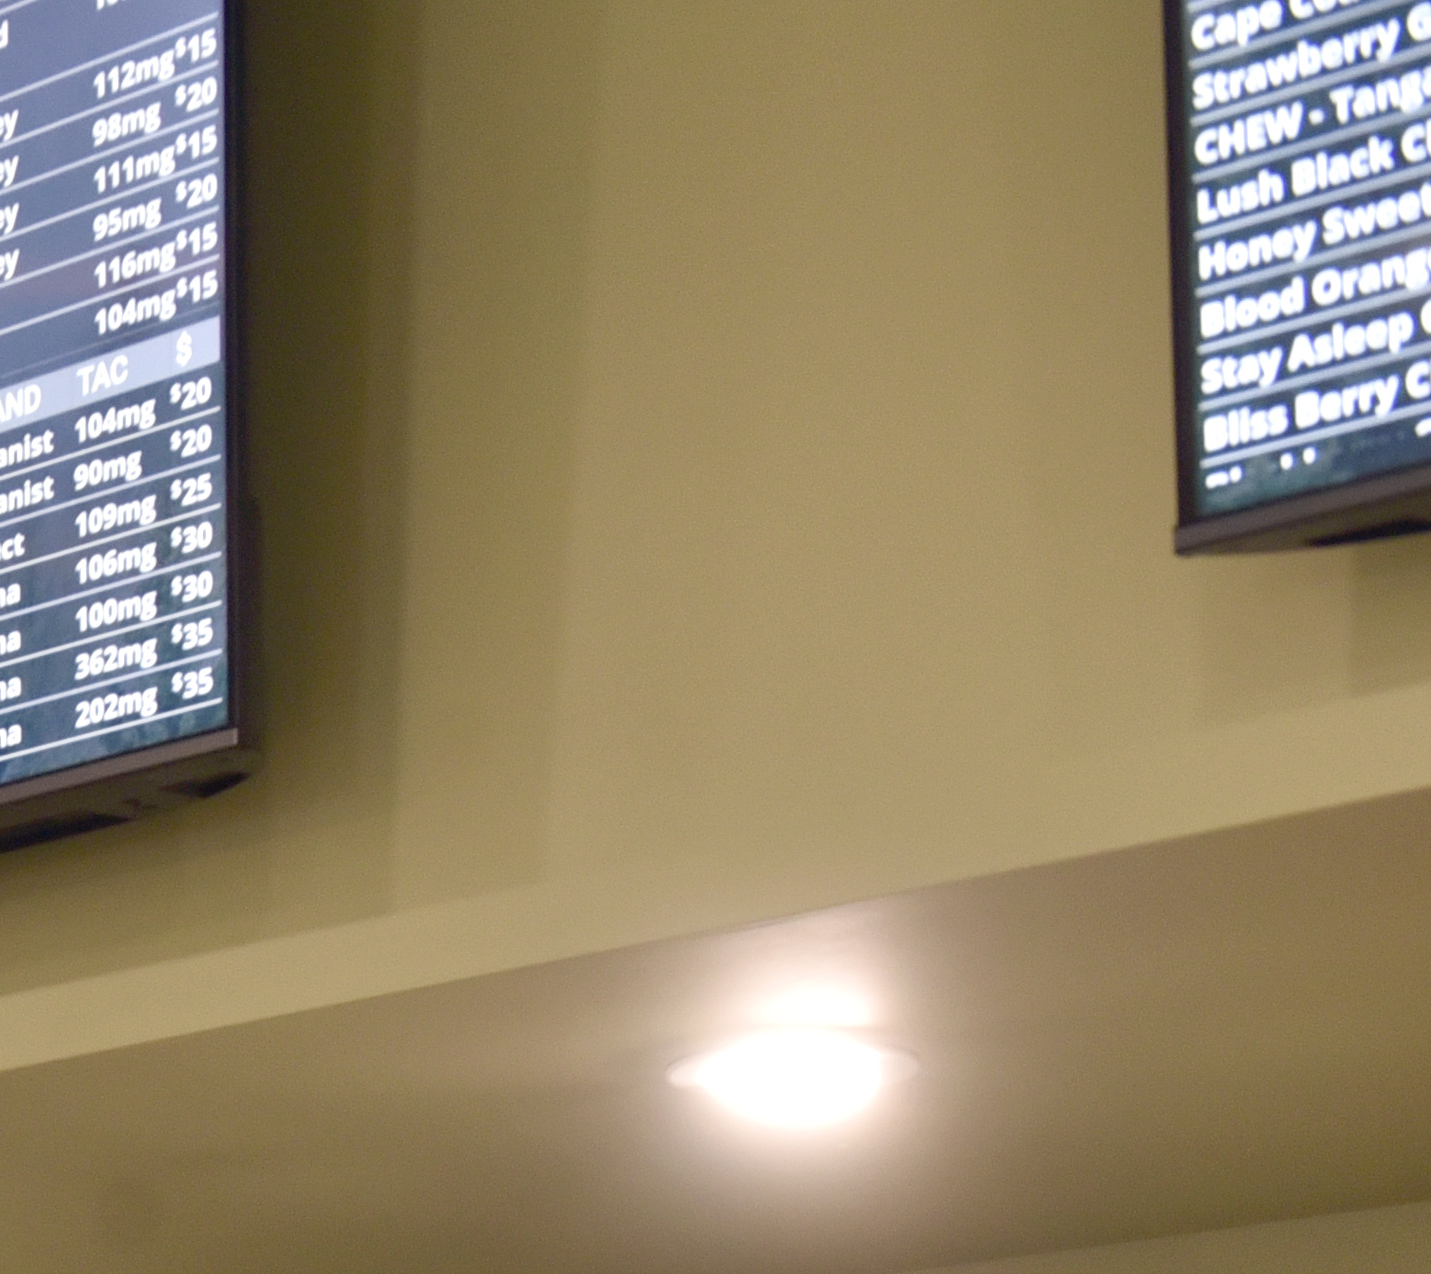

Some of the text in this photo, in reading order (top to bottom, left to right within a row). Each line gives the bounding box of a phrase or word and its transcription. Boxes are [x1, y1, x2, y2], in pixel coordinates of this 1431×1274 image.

[1192, 17, 1399, 109] Strawberry
[176, 125, 217, 158] $15
[1194, 101, 1302, 165] CHEW
[94, 145, 176, 193] 111mg
[1196, 135, 1395, 225] Lush Black
[1197, 217, 1317, 281] Honey
[1200, 277, 1305, 338] Blood
[1201, 310, 1414, 394] Stay Asleep
[1203, 373, 1399, 452] Bliss Berry
[75, 472, 212, 537] 109mg $25
